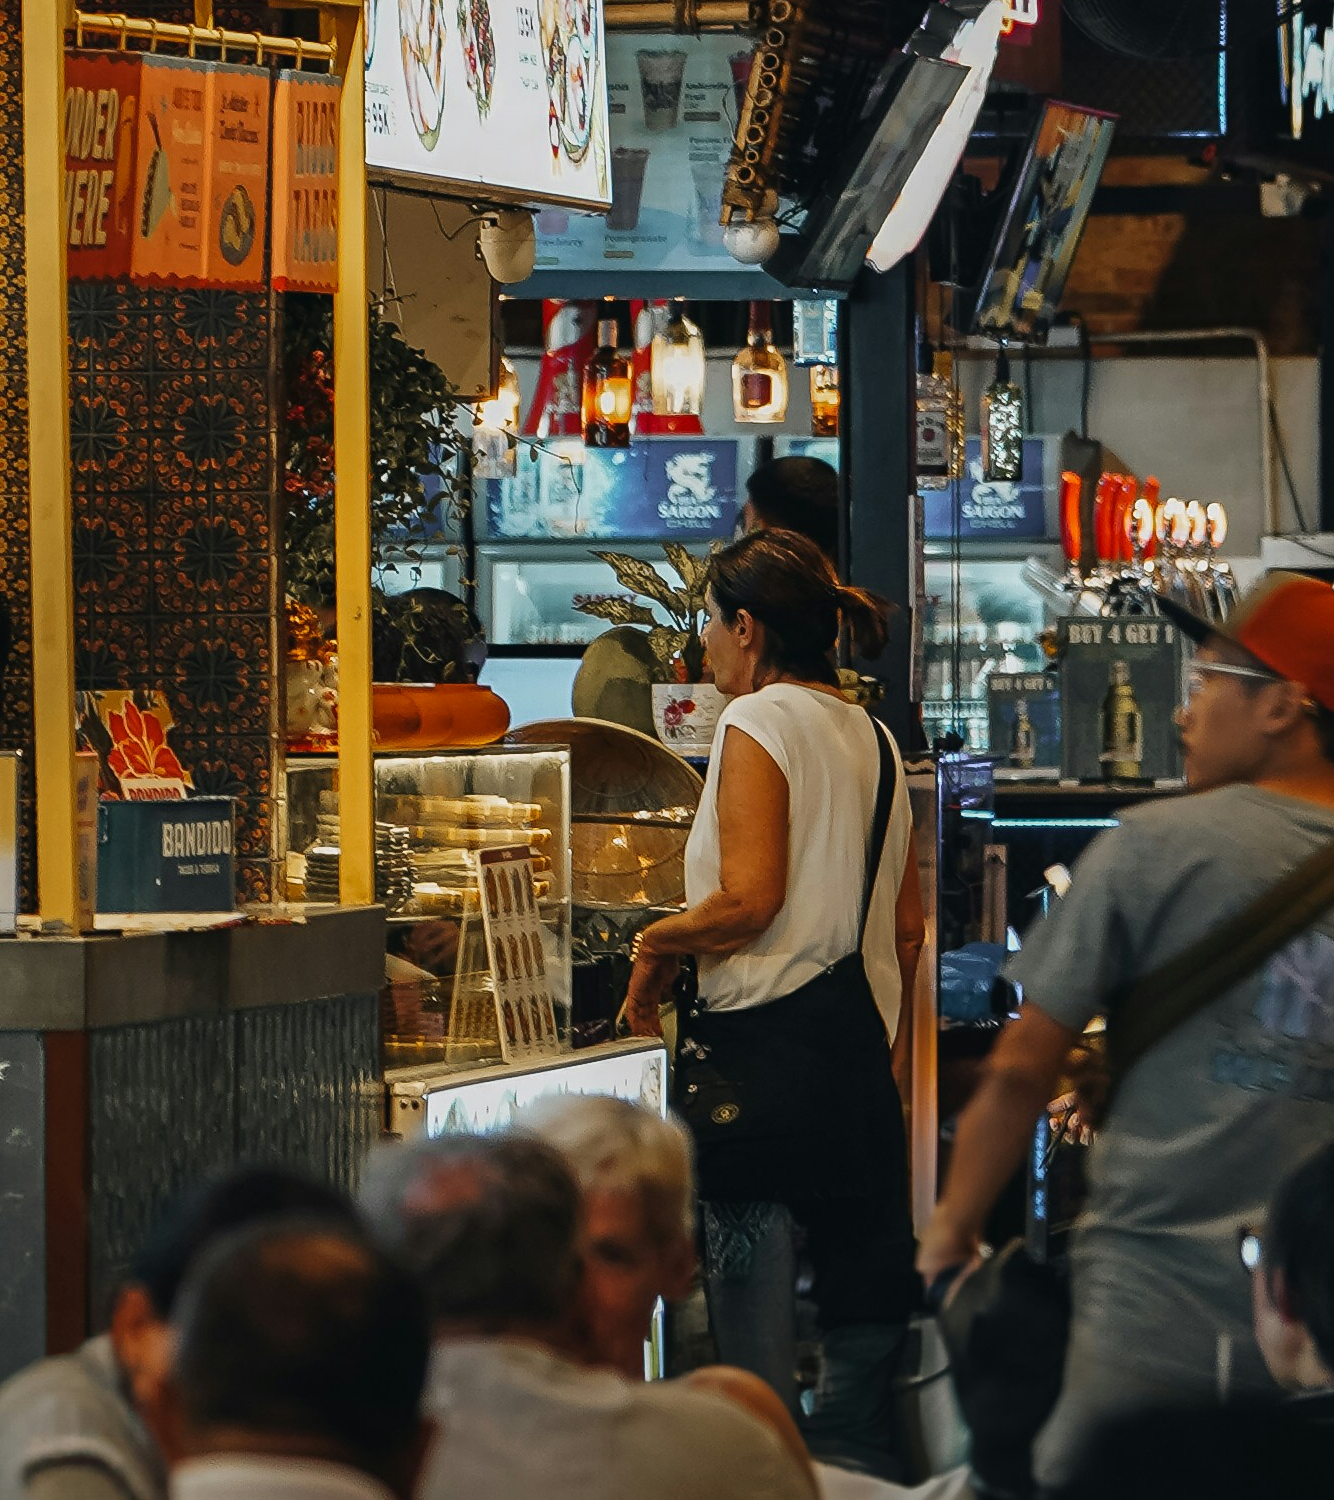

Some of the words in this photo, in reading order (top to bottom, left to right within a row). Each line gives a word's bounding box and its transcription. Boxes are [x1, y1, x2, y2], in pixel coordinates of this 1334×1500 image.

[657, 501, 722, 519] SAIGON
[961, 501, 1027, 519] SAIGON
[1068, 623, 1103, 644] BUY
[1107, 623, 1121, 644] 4
[1125, 623, 1159, 644] GET
[162, 820, 232, 858] BANDIDO
